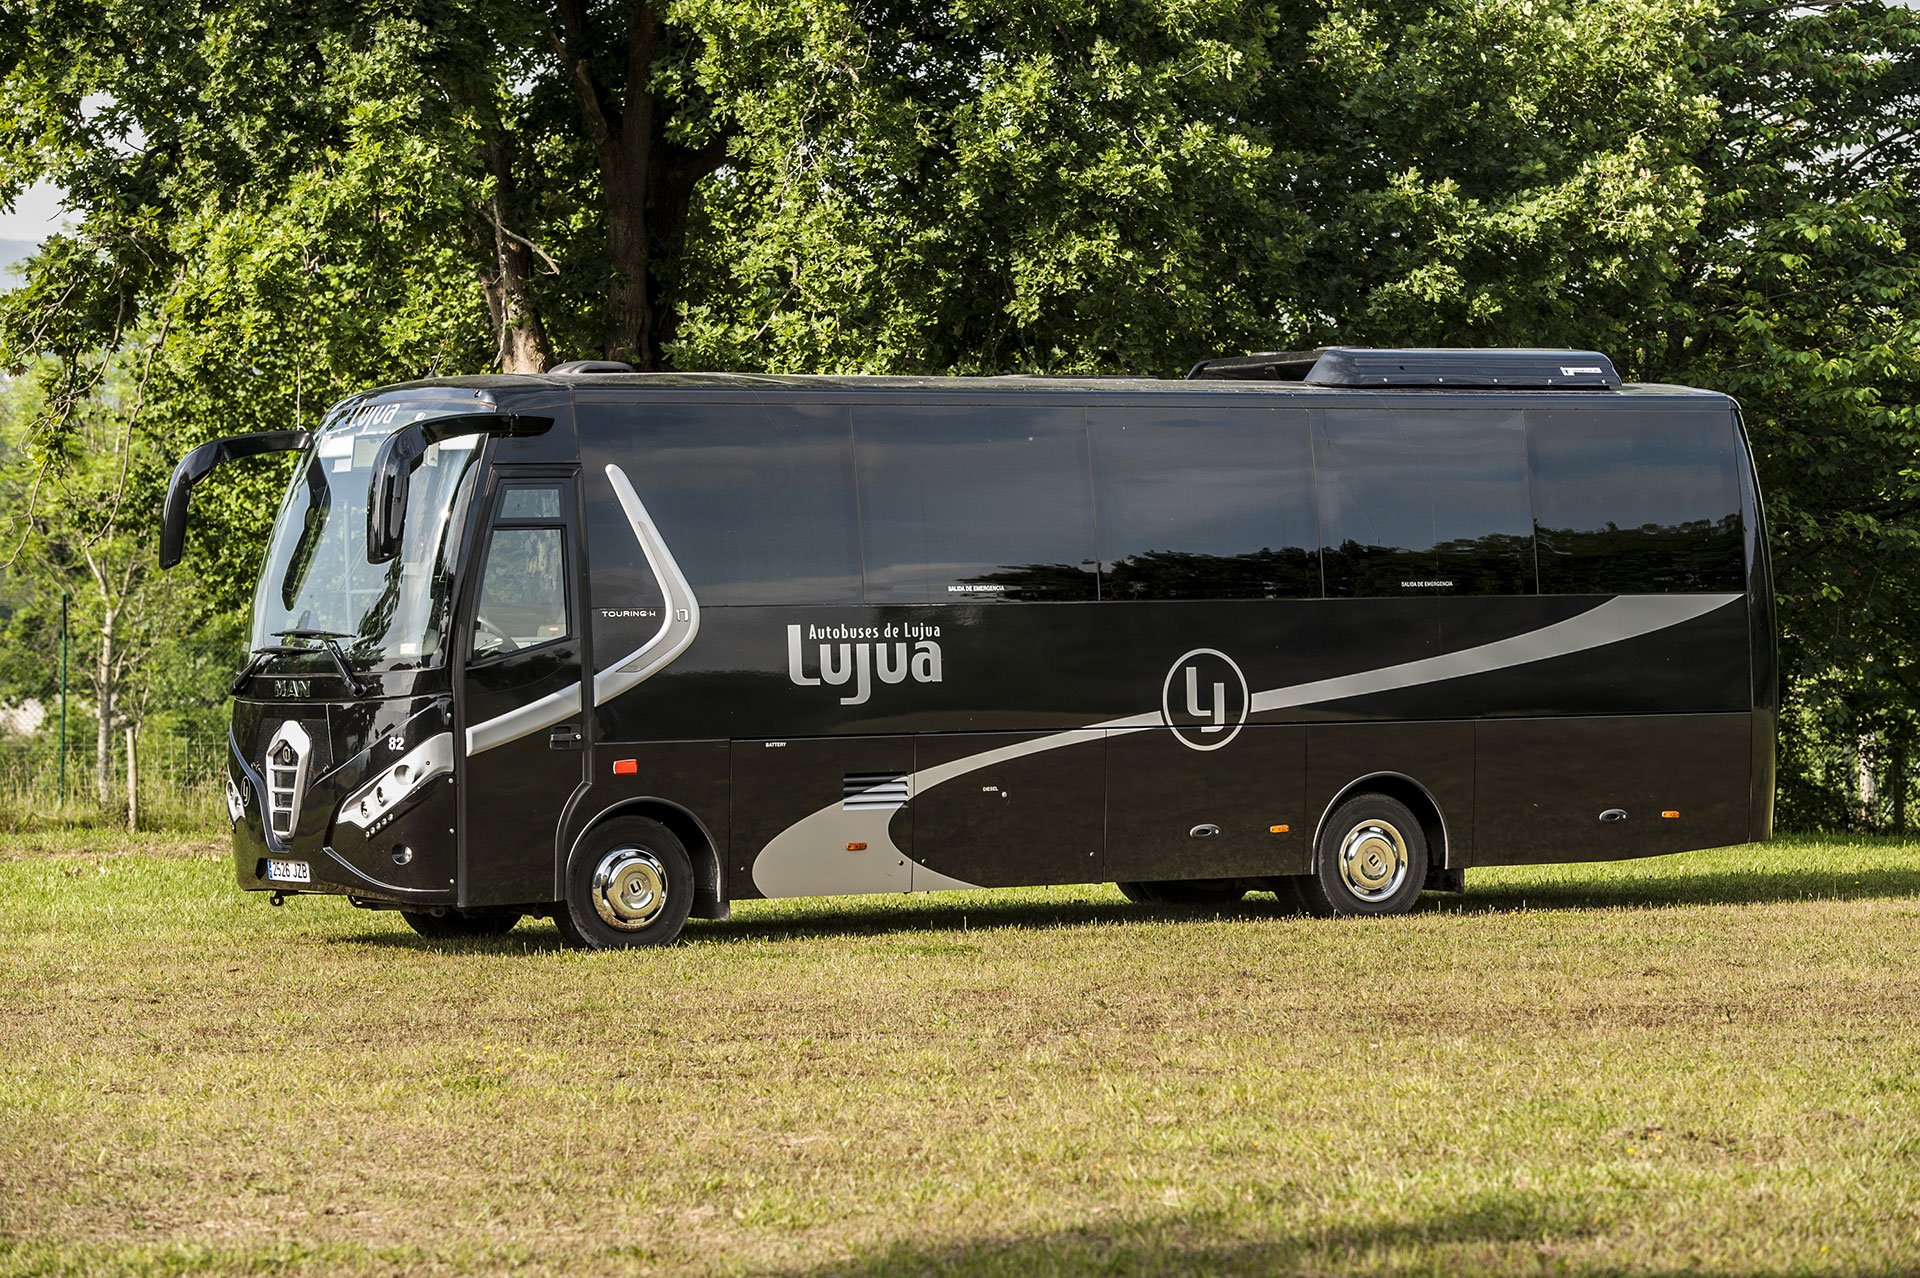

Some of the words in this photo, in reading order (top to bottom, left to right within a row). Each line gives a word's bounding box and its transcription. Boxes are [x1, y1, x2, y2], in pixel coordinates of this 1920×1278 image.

[349, 398, 400, 433] Lujua
[809, 623, 879, 640] Autobuses
[884, 622, 899, 638] de
[904, 622, 941, 640] Lujua
[787, 624, 943, 706] Lujua
[274, 680, 311, 698] MAN
[388, 736, 405, 751] 82
[272, 861, 290, 877] 2526
[293, 863, 308, 879] JZB
